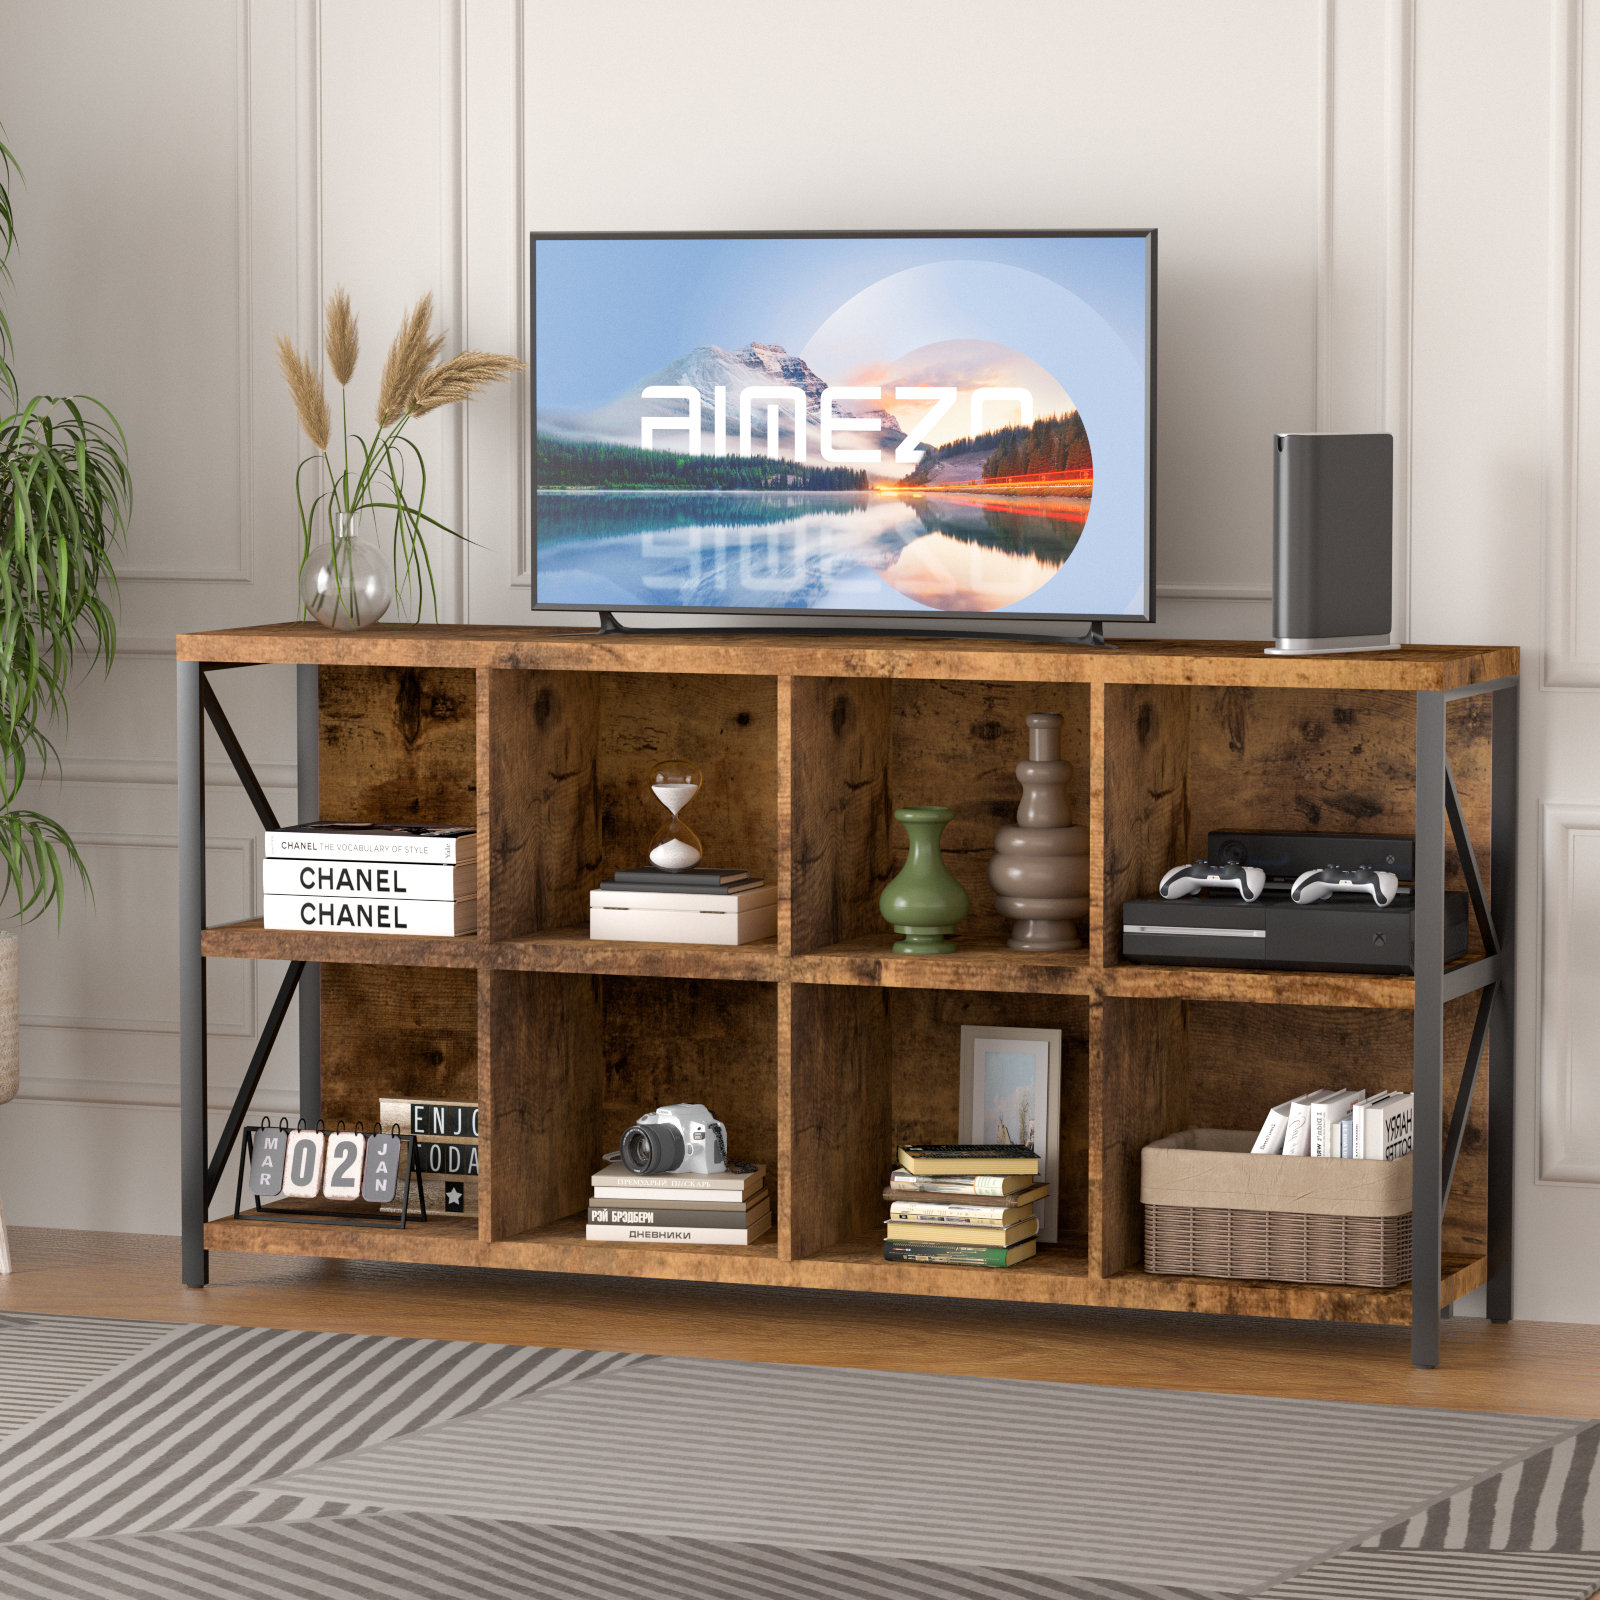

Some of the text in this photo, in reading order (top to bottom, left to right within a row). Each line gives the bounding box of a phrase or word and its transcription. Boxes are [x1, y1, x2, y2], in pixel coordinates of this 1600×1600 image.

[281, 841, 317, 851] CHANEL
[320, 842, 335, 851] THE
[337, 843, 390, 853] VOCABULARY
[392, 845, 402, 853] OF
[405, 845, 429, 854] STYLE
[300, 866, 407, 893] CHANEL
[300, 902, 408, 929] CHANEL
[414, 1143, 478, 1174] ODA
[591, 1208, 654, 1224] РЭЙ БРЭДБЕРИ
[629, 1230, 691, 1240] ДНЕВНИКИ
